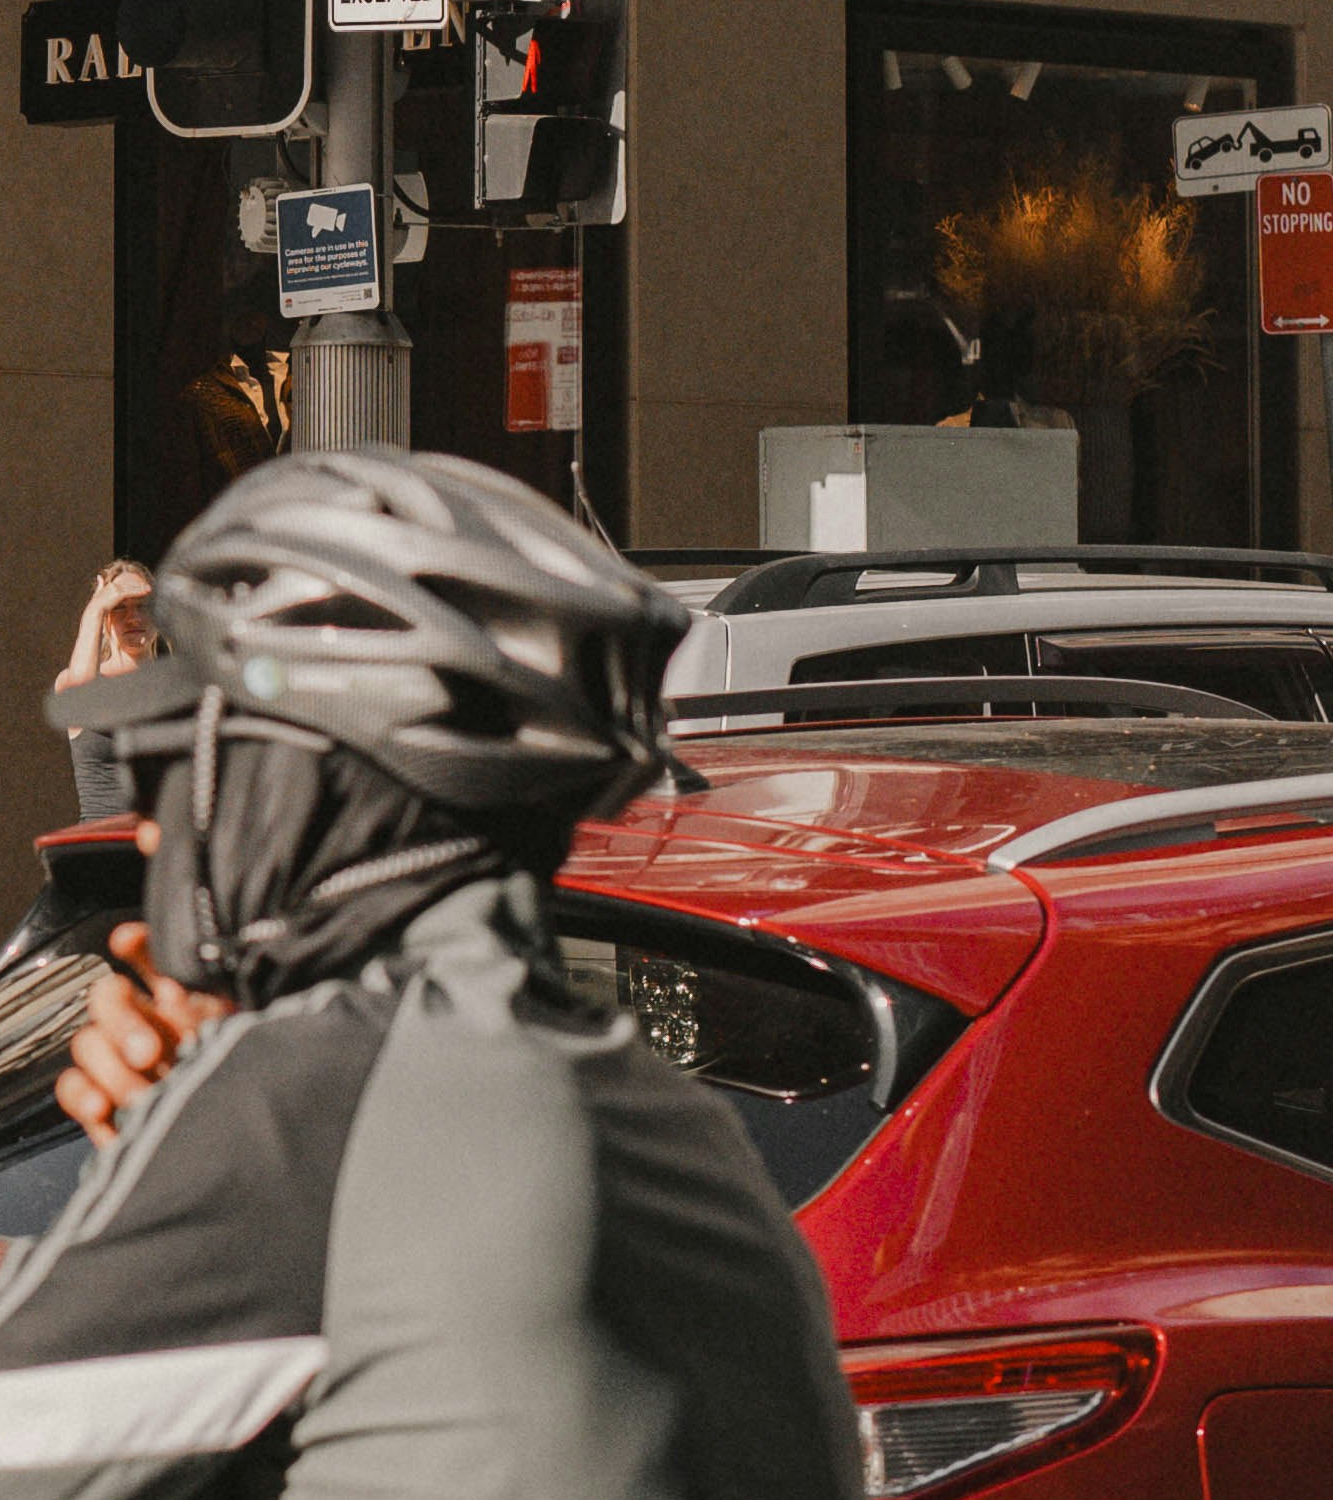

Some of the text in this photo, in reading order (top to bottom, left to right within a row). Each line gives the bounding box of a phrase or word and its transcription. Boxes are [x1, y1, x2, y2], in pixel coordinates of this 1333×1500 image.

[1282, 181, 1311, 206] NO
[1263, 211, 1333, 235] STOPPING
[285, 247, 314, 257] Cameras
[334, 242, 347, 251] use
[304, 255, 314, 263] for
[315, 253, 326, 262] the
[327, 251, 358, 261] purposes
[359, 249, 367, 257] of
